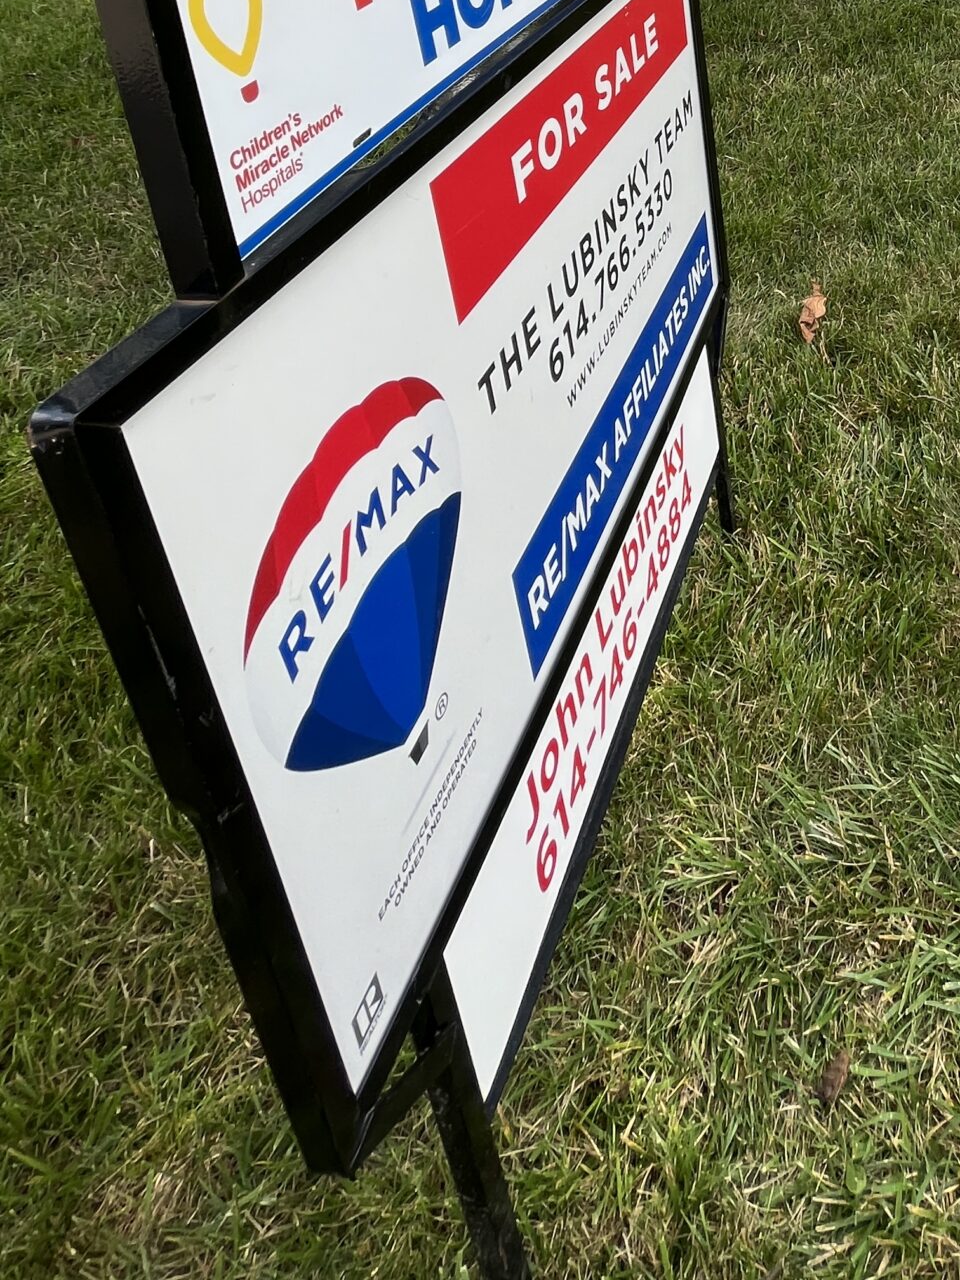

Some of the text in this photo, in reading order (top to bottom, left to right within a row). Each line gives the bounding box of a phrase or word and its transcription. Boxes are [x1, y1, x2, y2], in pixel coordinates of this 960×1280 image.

[229, 113, 302, 170] Children's
[234, 104, 344, 193] Miracle Network
[510, 92, 588, 205] FOR
[594, 13, 660, 111] SALE
[477, 90, 694, 415] THE LUBINSKY TEAM
[549, 168, 673, 384] 614.766.5330
[566, 222, 673, 408] WWW.LUBINSKYTEAM.COM
[527, 245, 711, 630] RE/MAX AFFILIATES INC.
[278, 434, 441, 685] RE/MAX
[525, 424, 686, 845] John Lubinsky
[536, 468, 693, 893] 614-746-4884
[377, 707, 484, 922] EACH OFFICE INDEPENDENTLY
[394, 738, 477, 908] OWNED AND OPERATED
